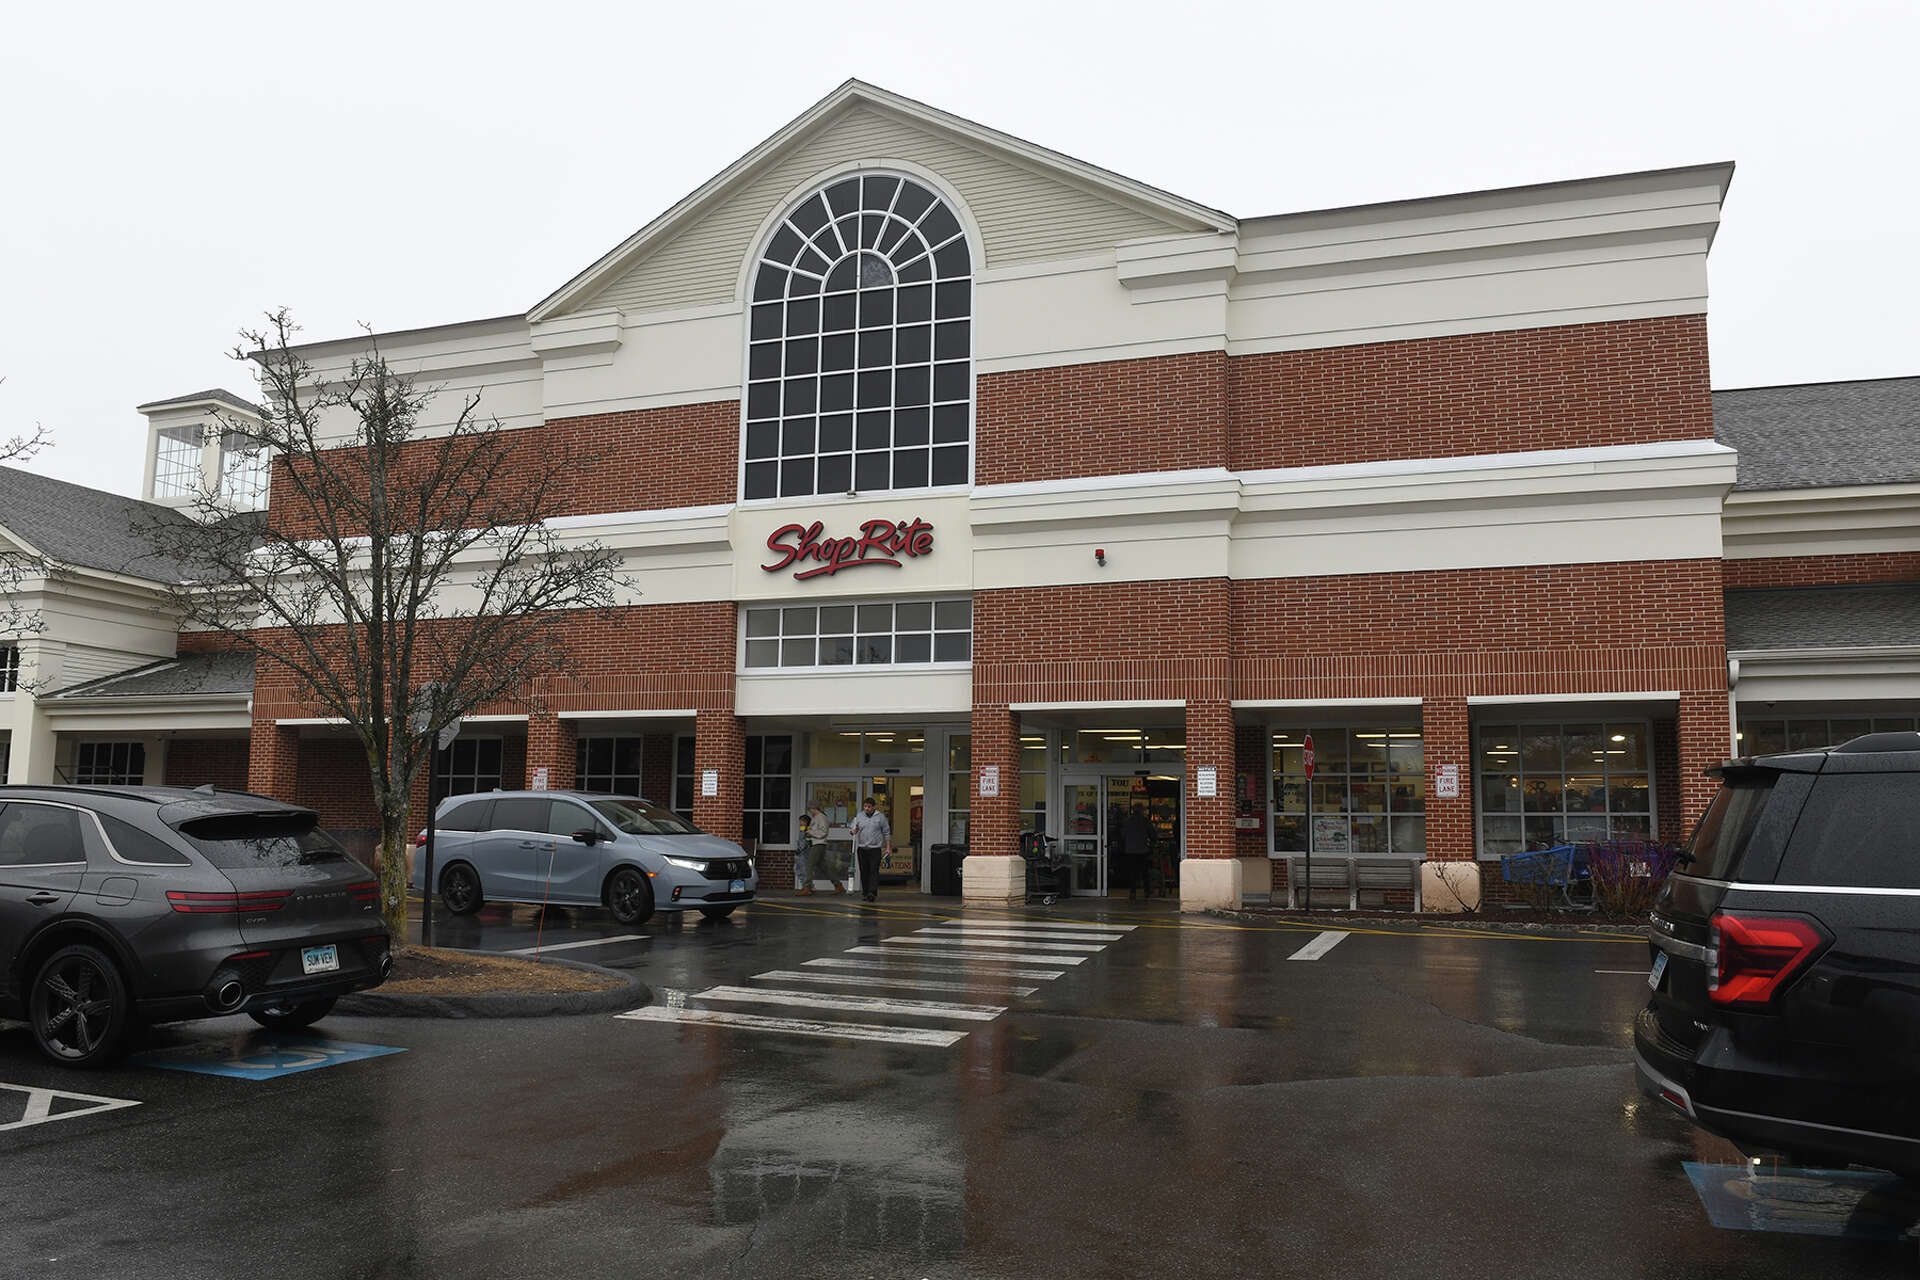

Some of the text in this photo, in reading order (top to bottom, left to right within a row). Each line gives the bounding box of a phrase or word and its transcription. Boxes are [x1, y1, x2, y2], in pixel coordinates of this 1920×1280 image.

[761, 516, 934, 581] ShopRite
[982, 777, 996, 785] FIRE
[1439, 777, 1455, 785] FIRE
[1439, 785, 1455, 793] LANE
